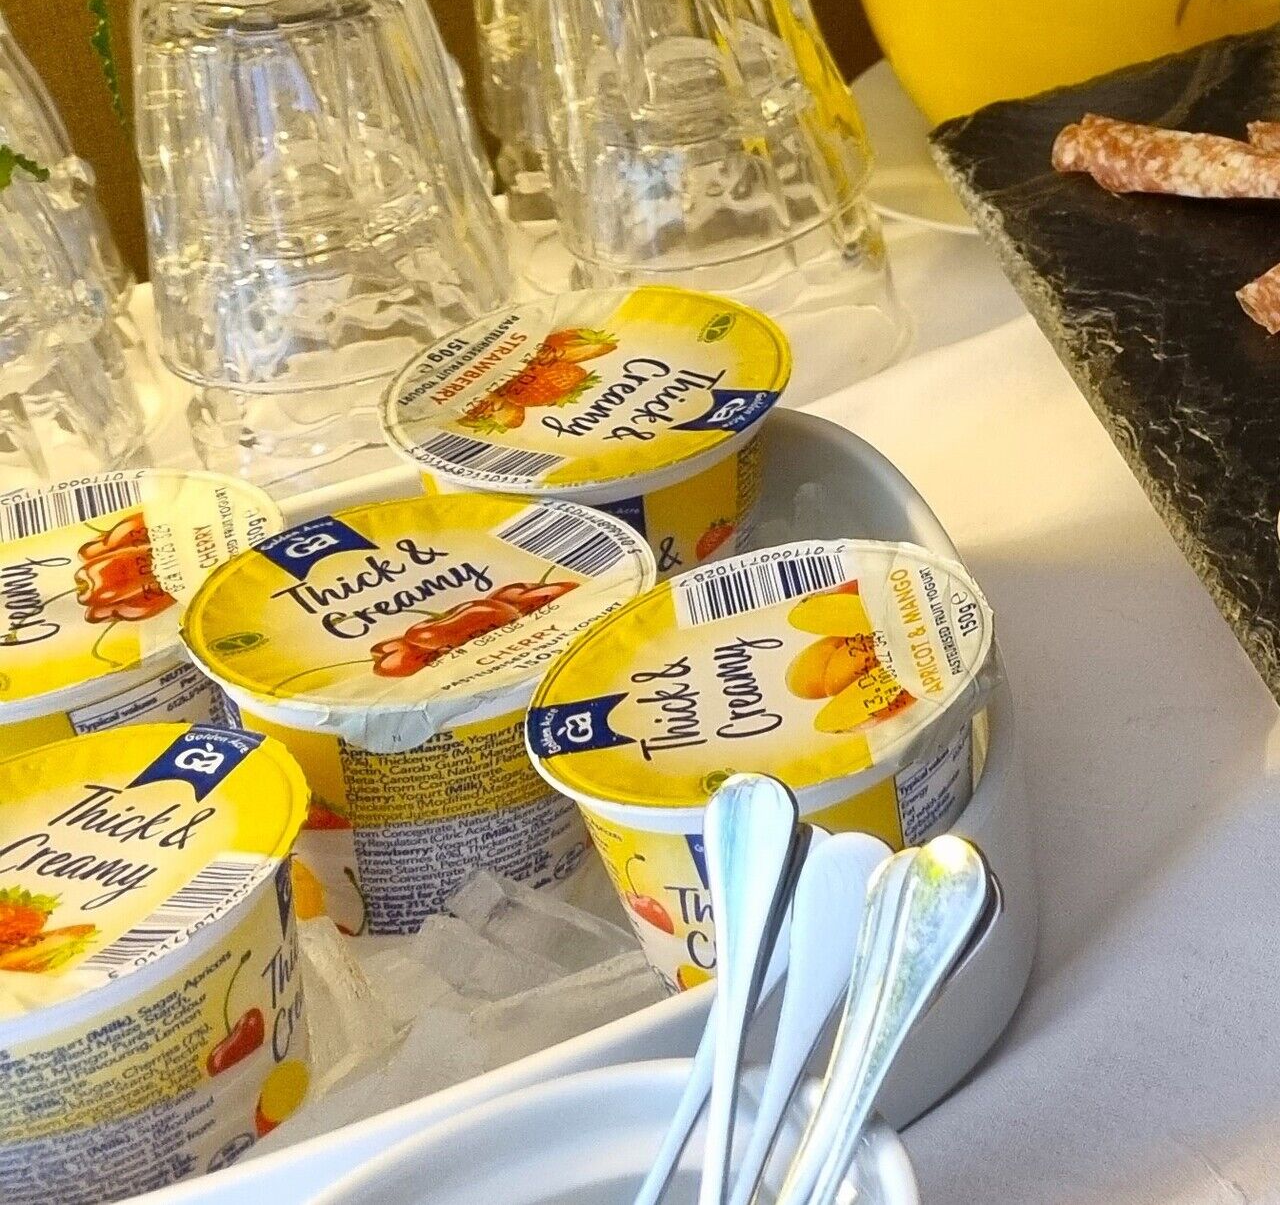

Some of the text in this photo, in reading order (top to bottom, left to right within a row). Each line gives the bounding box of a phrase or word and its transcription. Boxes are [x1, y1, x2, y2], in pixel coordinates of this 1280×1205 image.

[427, 338, 470, 363] 150g
[430, 332, 528, 405] STRAWBERRY
[439, 361, 464, 382] FRUIT
[542, 358, 671, 437] Creamy
[602, 369, 727, 442] Thick &
[193, 524, 219, 569] CHERRY
[270, 539, 449, 614] Thick &
[0, 557, 72, 646] Creamy
[322, 560, 493, 639] Creamy
[919, 566, 941, 600] YOGURT
[931, 599, 947, 624] FRUIT
[475, 624, 563, 666] CHERRY
[890, 568, 945, 695] APRICOT & MANGO
[959, 604, 980, 638] 150g
[78, 711, 119, 731] Typical
[631, 656, 708, 761] Thick &
[714, 637, 783, 738] Creamy
[185, 732, 229, 745] Golden
[48, 784, 216, 849] Thick &
[0, 833, 158, 911] Creamy
